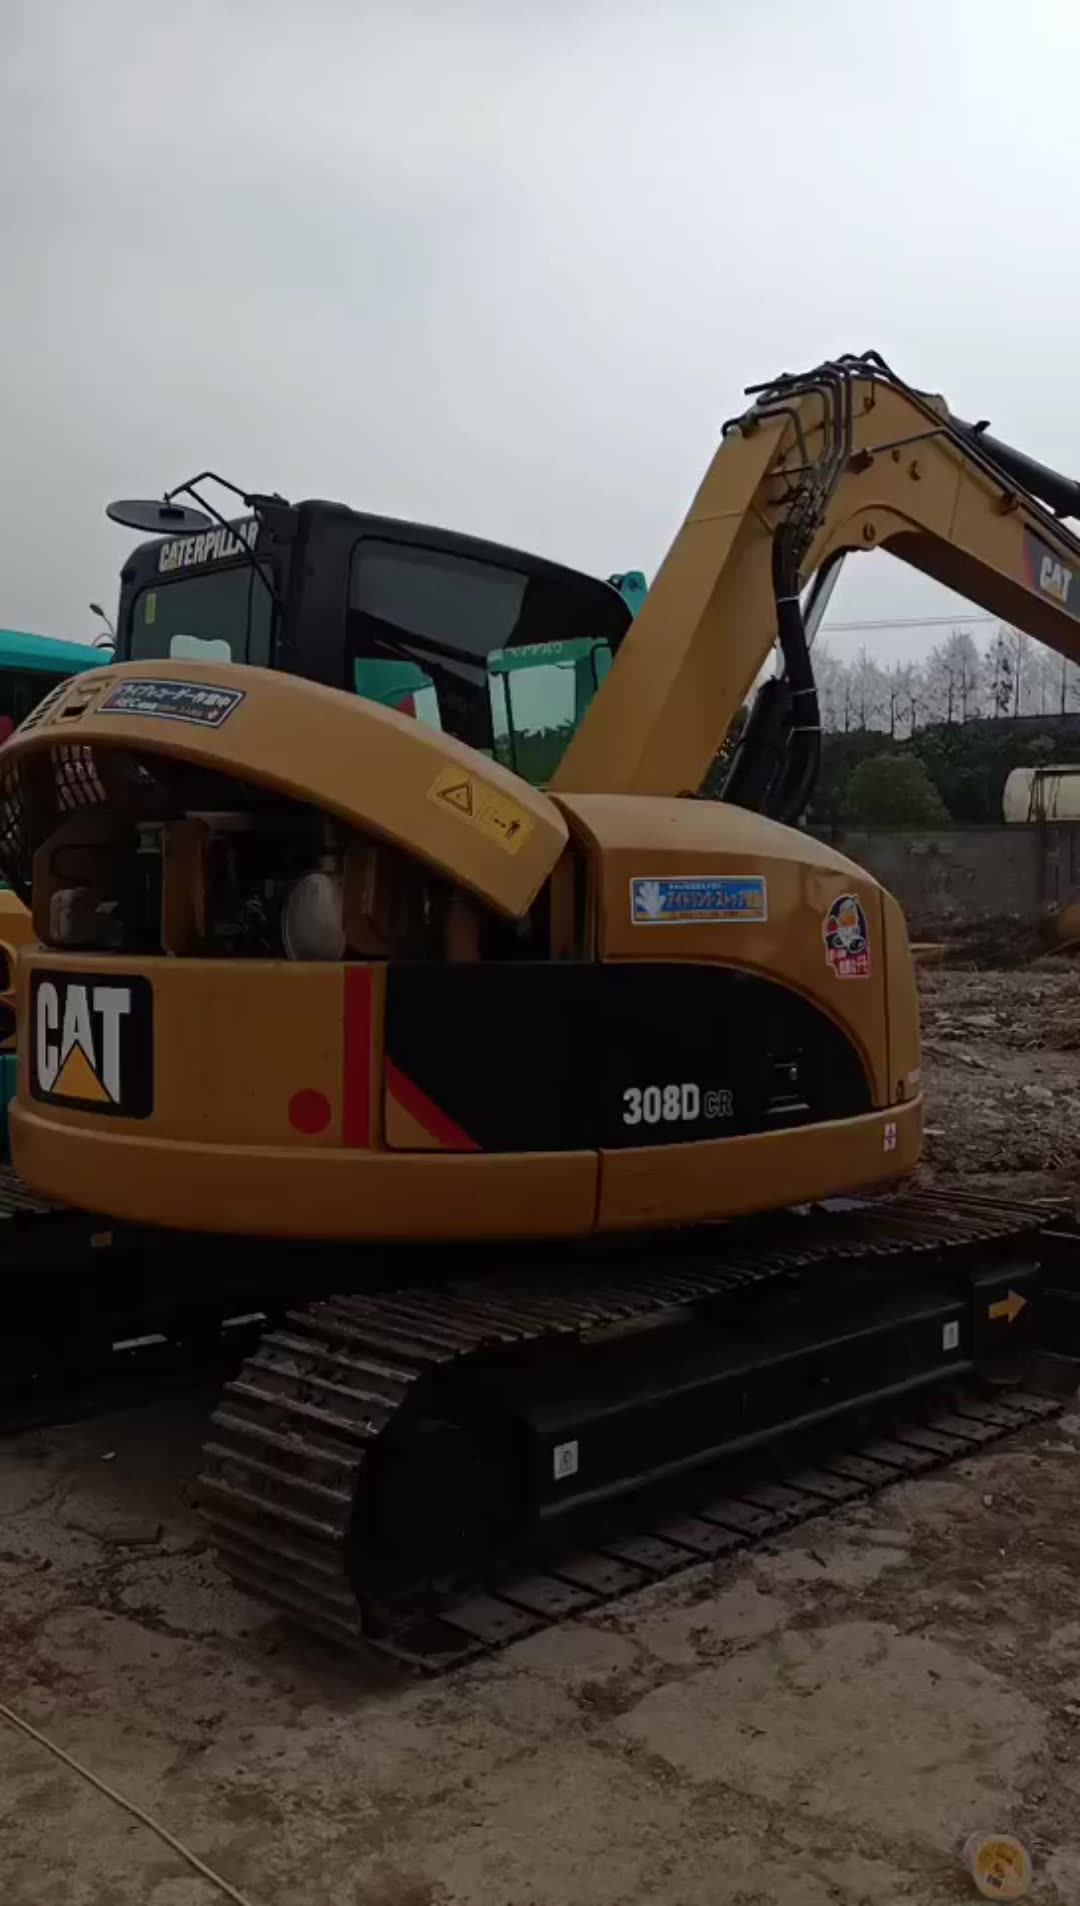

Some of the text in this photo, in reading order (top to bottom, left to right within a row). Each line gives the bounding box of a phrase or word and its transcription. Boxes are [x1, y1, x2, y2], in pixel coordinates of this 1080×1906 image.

[158, 520, 260, 573] CATERPILLAR
[1040, 555, 1073, 603] CAT
[37, 981, 132, 1105] CAT
[622, 1083, 734, 1125] 308D CR
